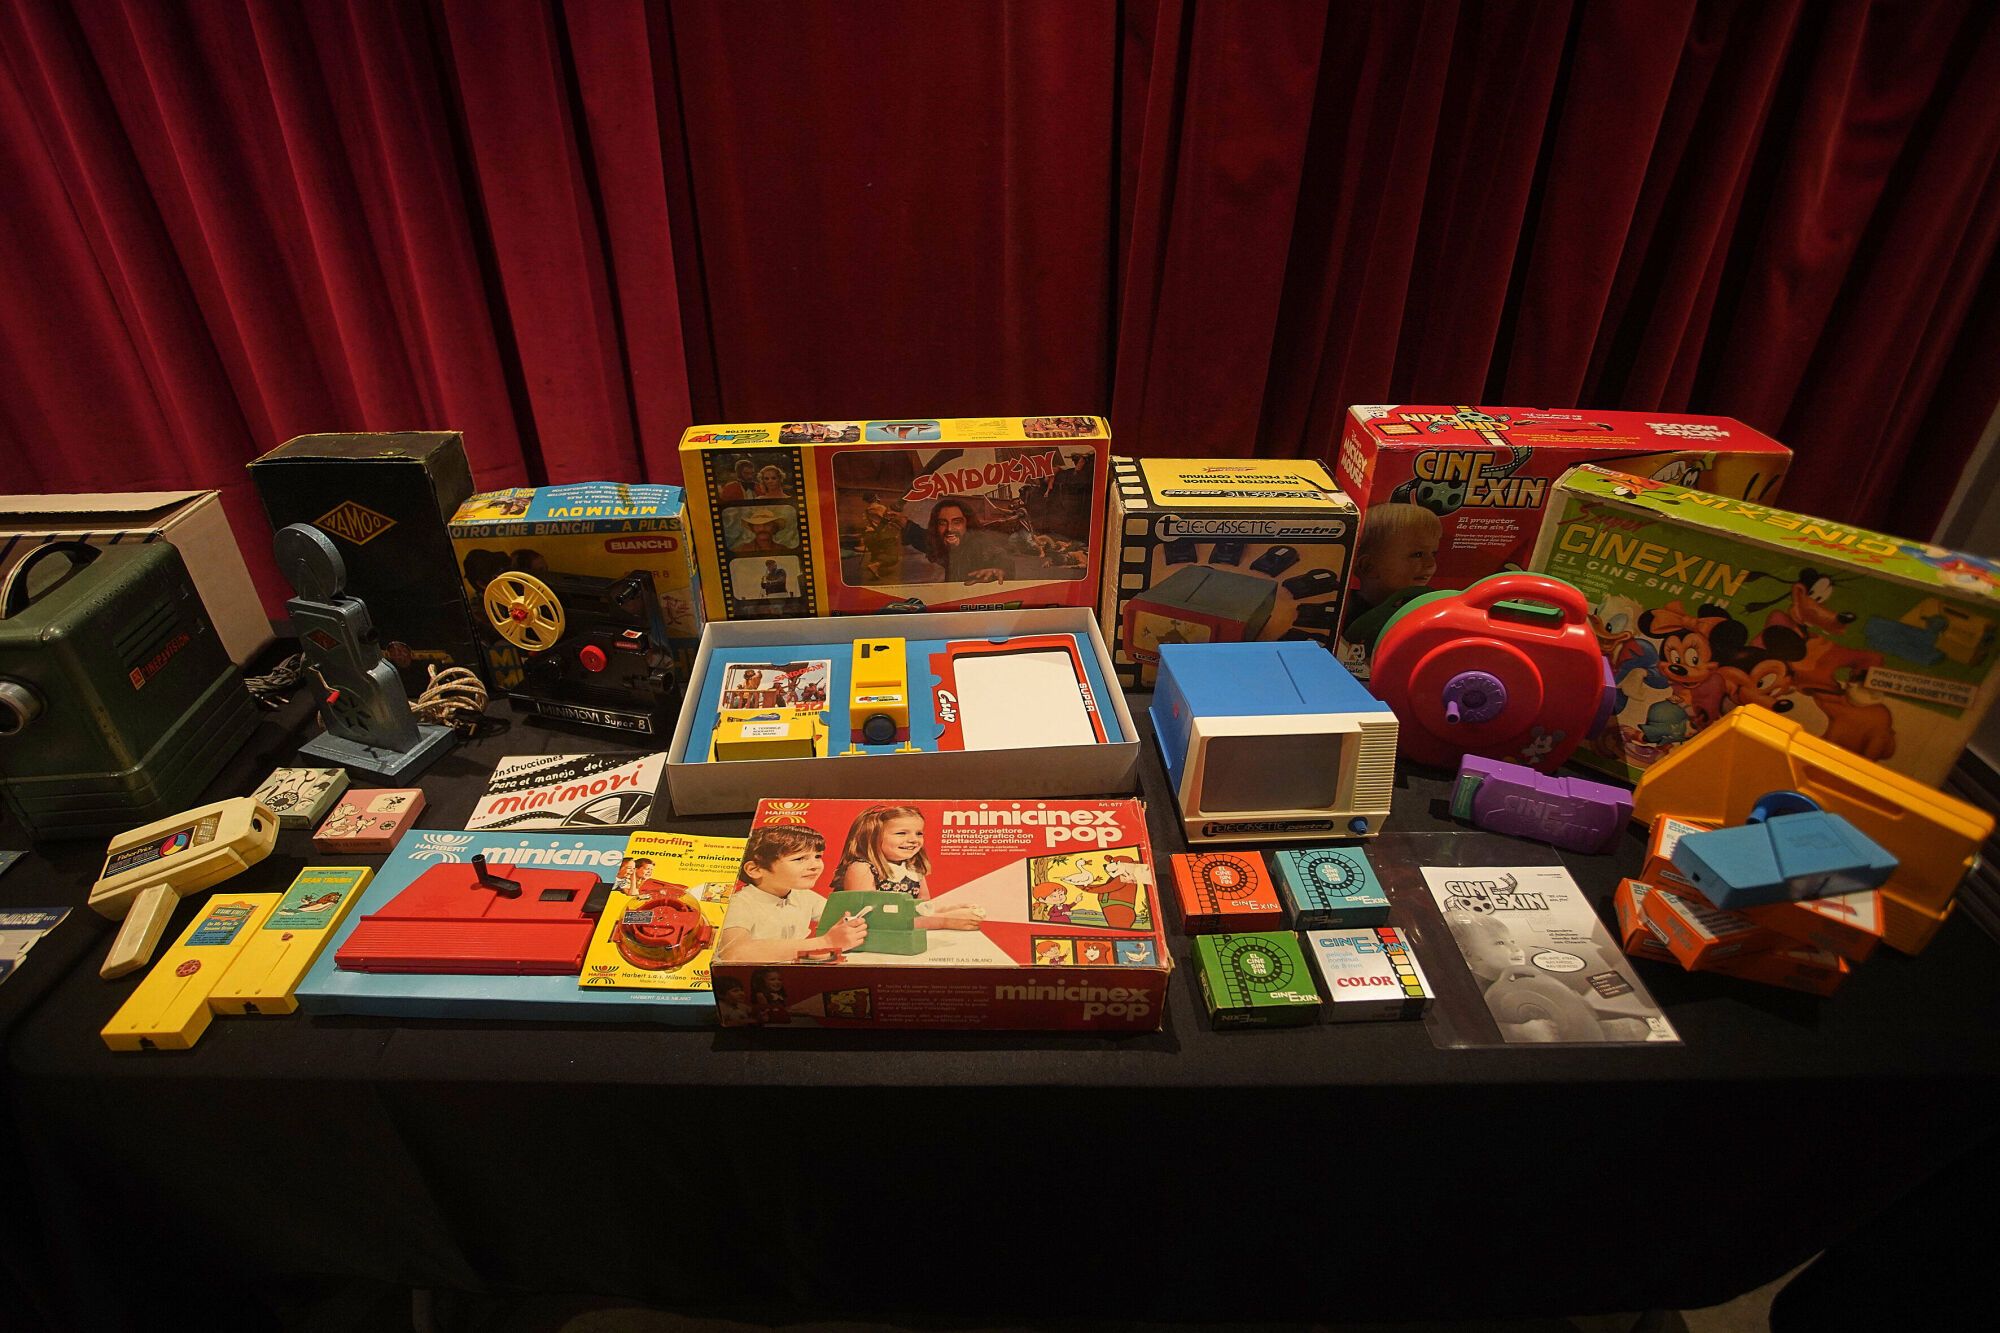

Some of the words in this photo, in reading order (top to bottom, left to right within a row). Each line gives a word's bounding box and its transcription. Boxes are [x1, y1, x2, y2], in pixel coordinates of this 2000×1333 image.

[902, 450, 1056, 501] SANDOKAN
[548, 506, 658, 518] MINIMOVI
[452, 525, 490, 538] OTRO
[495, 524, 528, 537] CINE
[535, 522, 595, 535] BIANCHI
[622, 520, 632, 532] A
[638, 519, 680, 531] PILAS
[1276, 526, 1342, 537] pactra
[1677, 492, 1900, 557] CINEXIN
[611, 539, 673, 550] BIANCHI
[1559, 524, 1749, 597] CINEXIN
[1553, 553, 1577, 566] EL
[1586, 561, 1638, 582] CINE
[1645, 577, 1684, 595] SIN
[773, 663, 825, 682] SANDOKAN
[1079, 683, 1095, 712] SUPER
[542, 703, 600, 722] MINIMOVI
[604, 714, 634, 729] Super
[638, 719, 646, 729] 8
[494, 754, 564, 778] instrucciones
[489, 780, 516, 791] para
[519, 777, 530, 786] el
[534, 769, 575, 783] manejo
[942, 803, 1119, 825] minicinex
[635, 836, 693, 847] motorfilm
[1046, 826, 1123, 848] pop
[414, 843, 468, 852] HARBERT
[480, 840, 626, 866] minicine
[631, 849, 683, 858] motorcinex
[698, 854, 742, 862] minicinex
[1231, 900, 1278, 910] CINEXIN
[1345, 895, 1389, 904] CINEXIN
[1320, 937, 1410, 954] CINEXIN
[995, 978, 1148, 1002] minicinex
[1337, 976, 1395, 987] COLOR
[1270, 991, 1318, 1002] CINEXIN
[1082, 1002, 1150, 1021] pop
